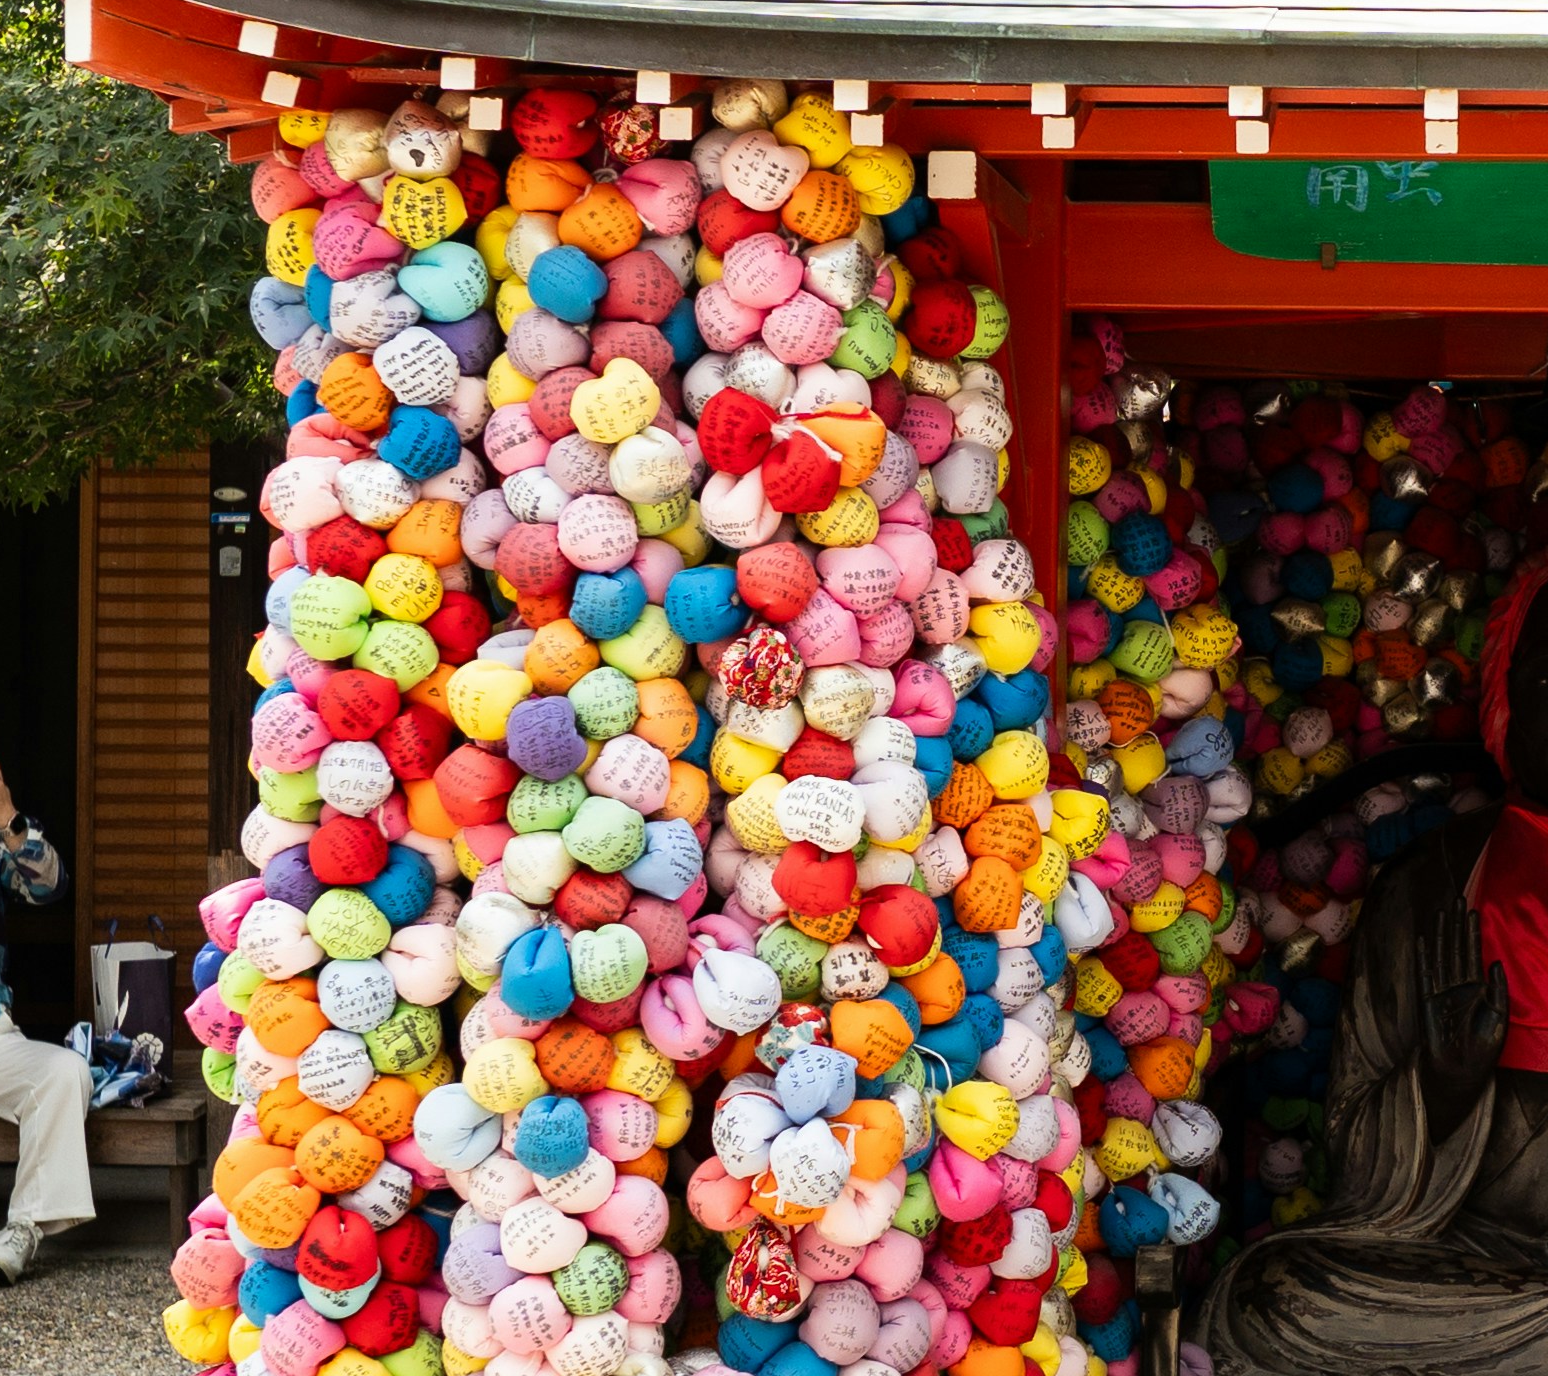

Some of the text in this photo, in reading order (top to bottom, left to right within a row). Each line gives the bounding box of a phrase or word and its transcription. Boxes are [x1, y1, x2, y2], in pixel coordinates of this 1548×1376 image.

[375, 560, 410, 593] Peace
[1069, 707, 1102, 729] 楽しく
[829, 784, 854, 801] TAKE
[328, 907, 366, 931] JOY
